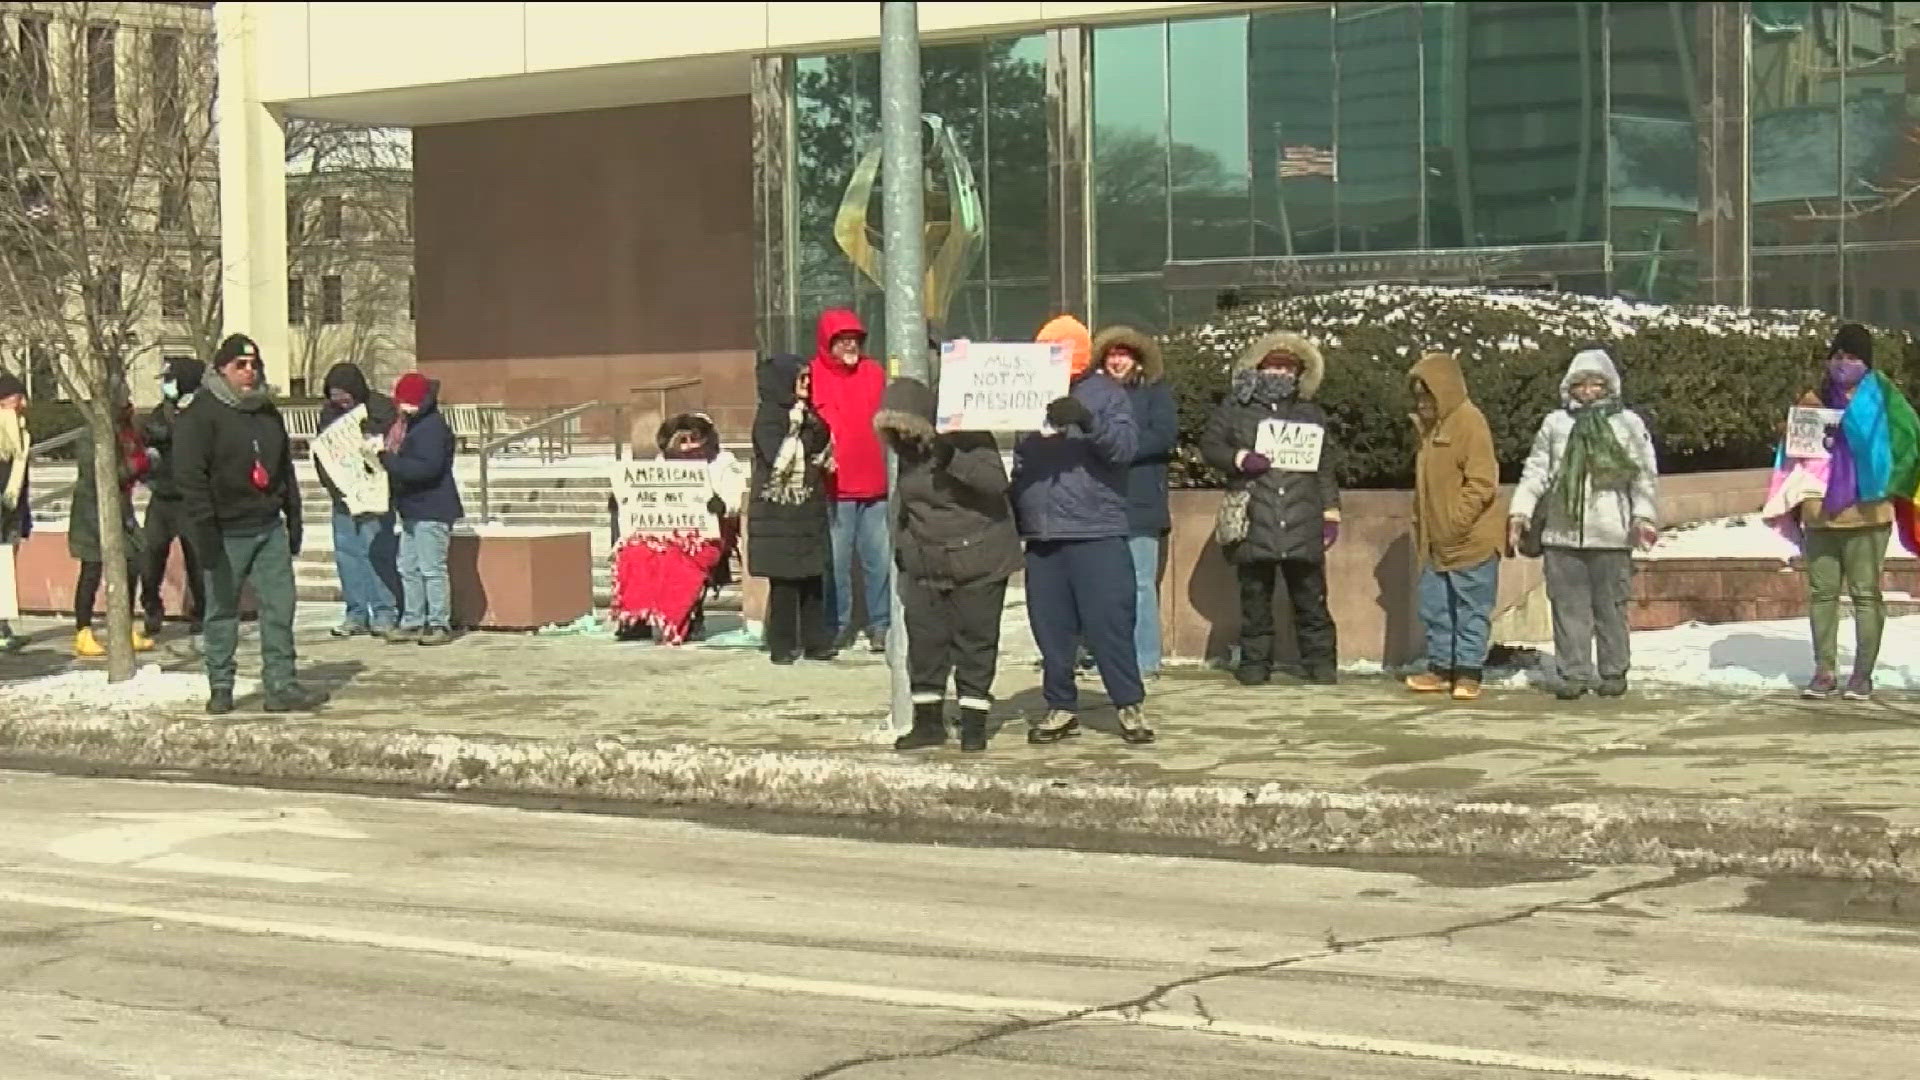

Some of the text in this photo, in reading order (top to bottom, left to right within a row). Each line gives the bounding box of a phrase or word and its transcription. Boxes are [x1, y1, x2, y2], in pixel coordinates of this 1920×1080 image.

[974, 372, 1011, 386] NOT
[963, 390, 1055, 410] PRESIDENT
[624, 466, 705, 484] AMERICANS
[637, 491, 657, 503] ARE
[631, 513, 706, 527] PARASITES
